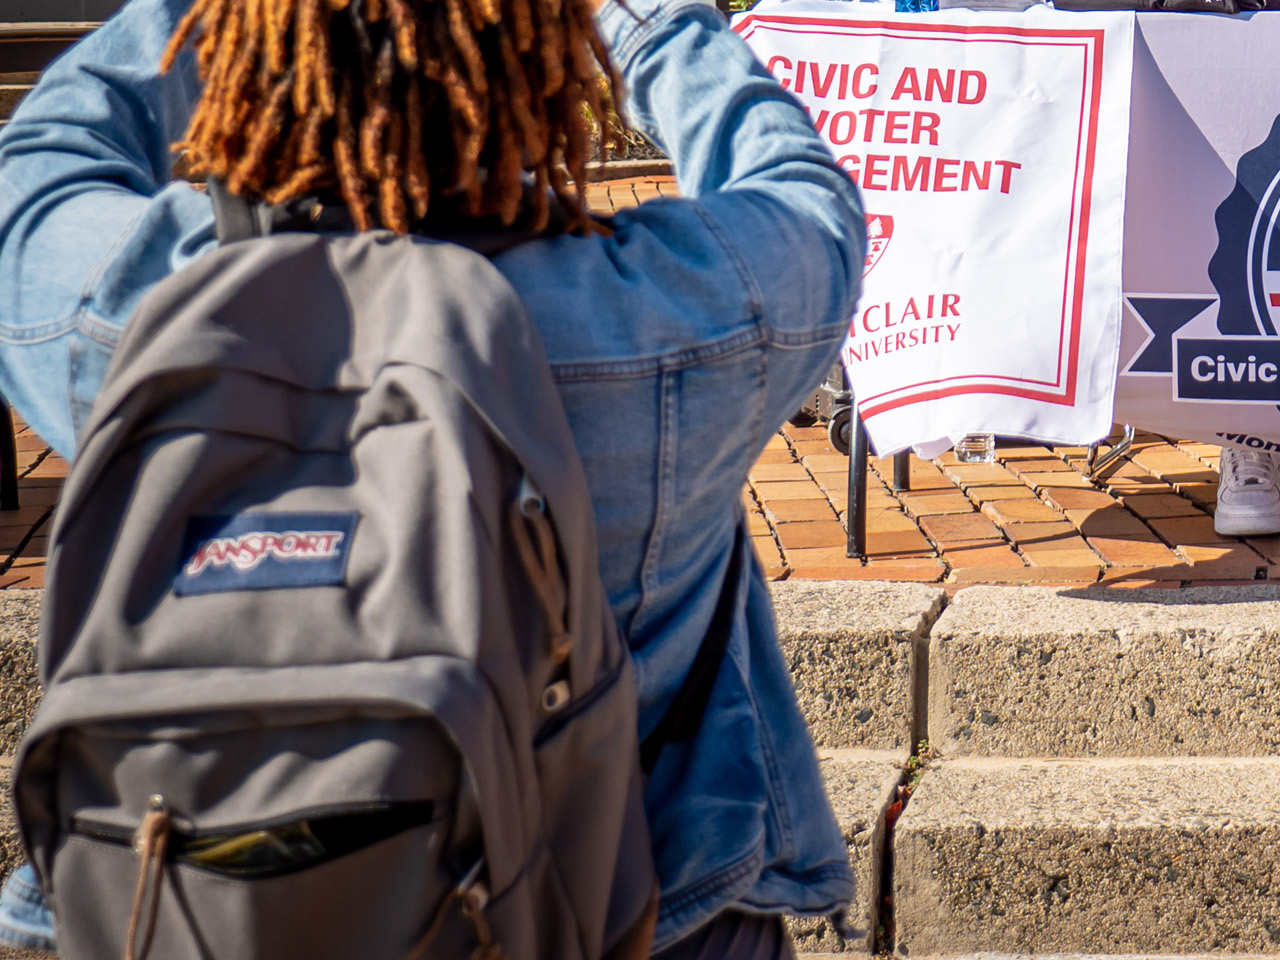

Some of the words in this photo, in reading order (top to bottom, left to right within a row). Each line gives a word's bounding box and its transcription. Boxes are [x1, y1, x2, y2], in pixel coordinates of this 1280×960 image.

[767, 55, 879, 100] CIVIC
[891, 66, 988, 105] AND
[804, 106, 941, 146] VOTER
[849, 293, 961, 337] CLAIR
[1190, 354, 1278, 382] Civic
[186, 531, 345, 575] JANSPORT
